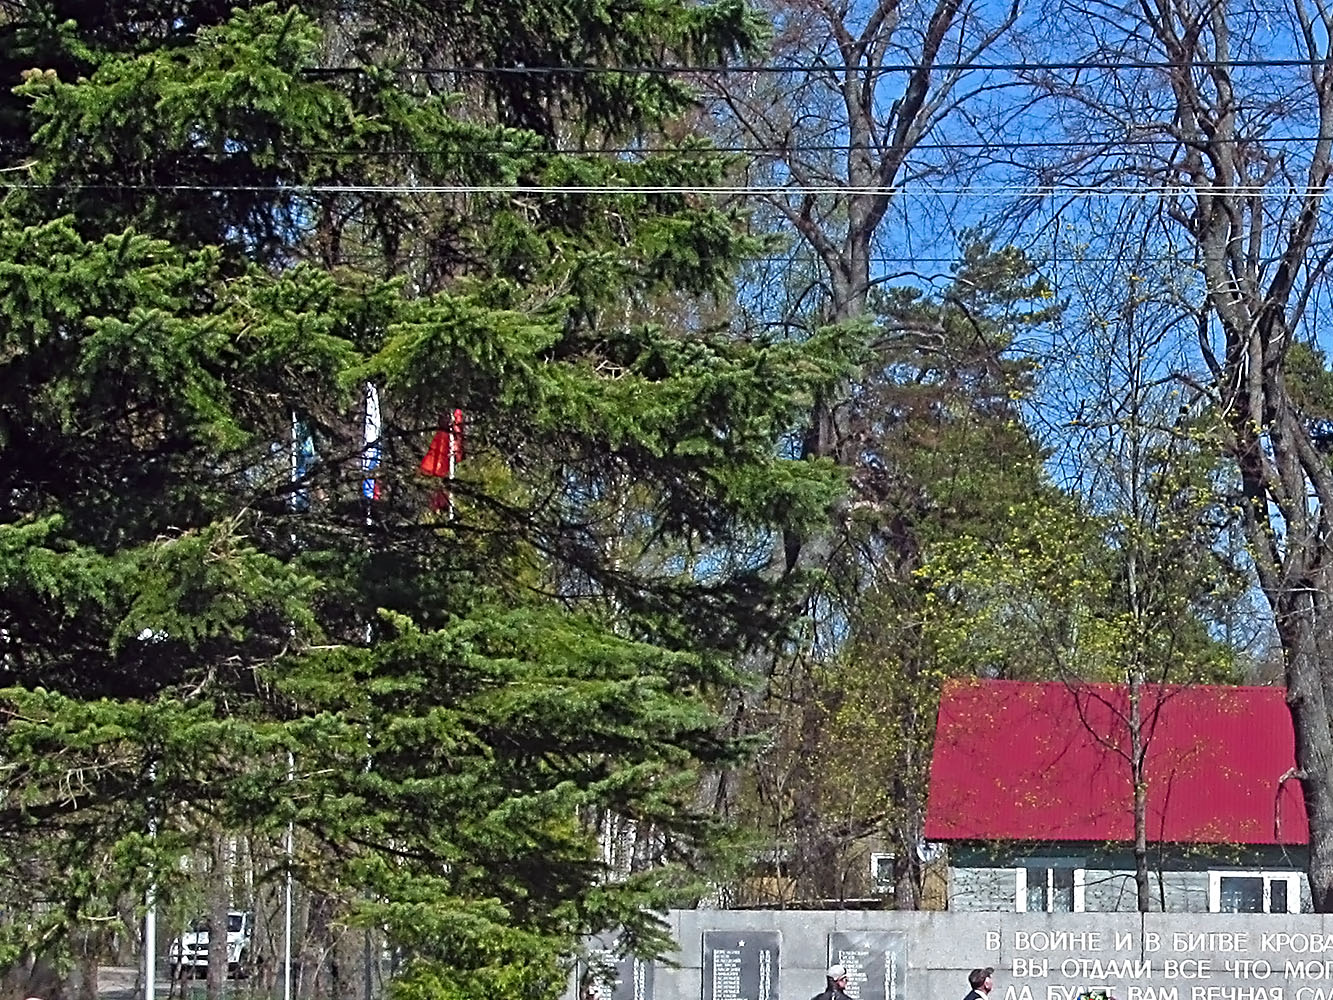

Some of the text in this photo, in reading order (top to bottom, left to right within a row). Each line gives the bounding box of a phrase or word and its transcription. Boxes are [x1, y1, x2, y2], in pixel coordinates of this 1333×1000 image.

[985, 931, 1001, 951] В
[1015, 930, 1100, 952] ВОЙНЕ
[1115, 932, 1133, 951] И
[1145, 932, 1161, 952] В
[1173, 932, 1248, 952] БИТВЕ
[1012, 958, 1048, 977] ВЫ
[1061, 958, 1152, 980] ОТДАЛИ
[1164, 959, 1211, 979] ВСЕ
[1225, 960, 1271, 979] ЧТО
